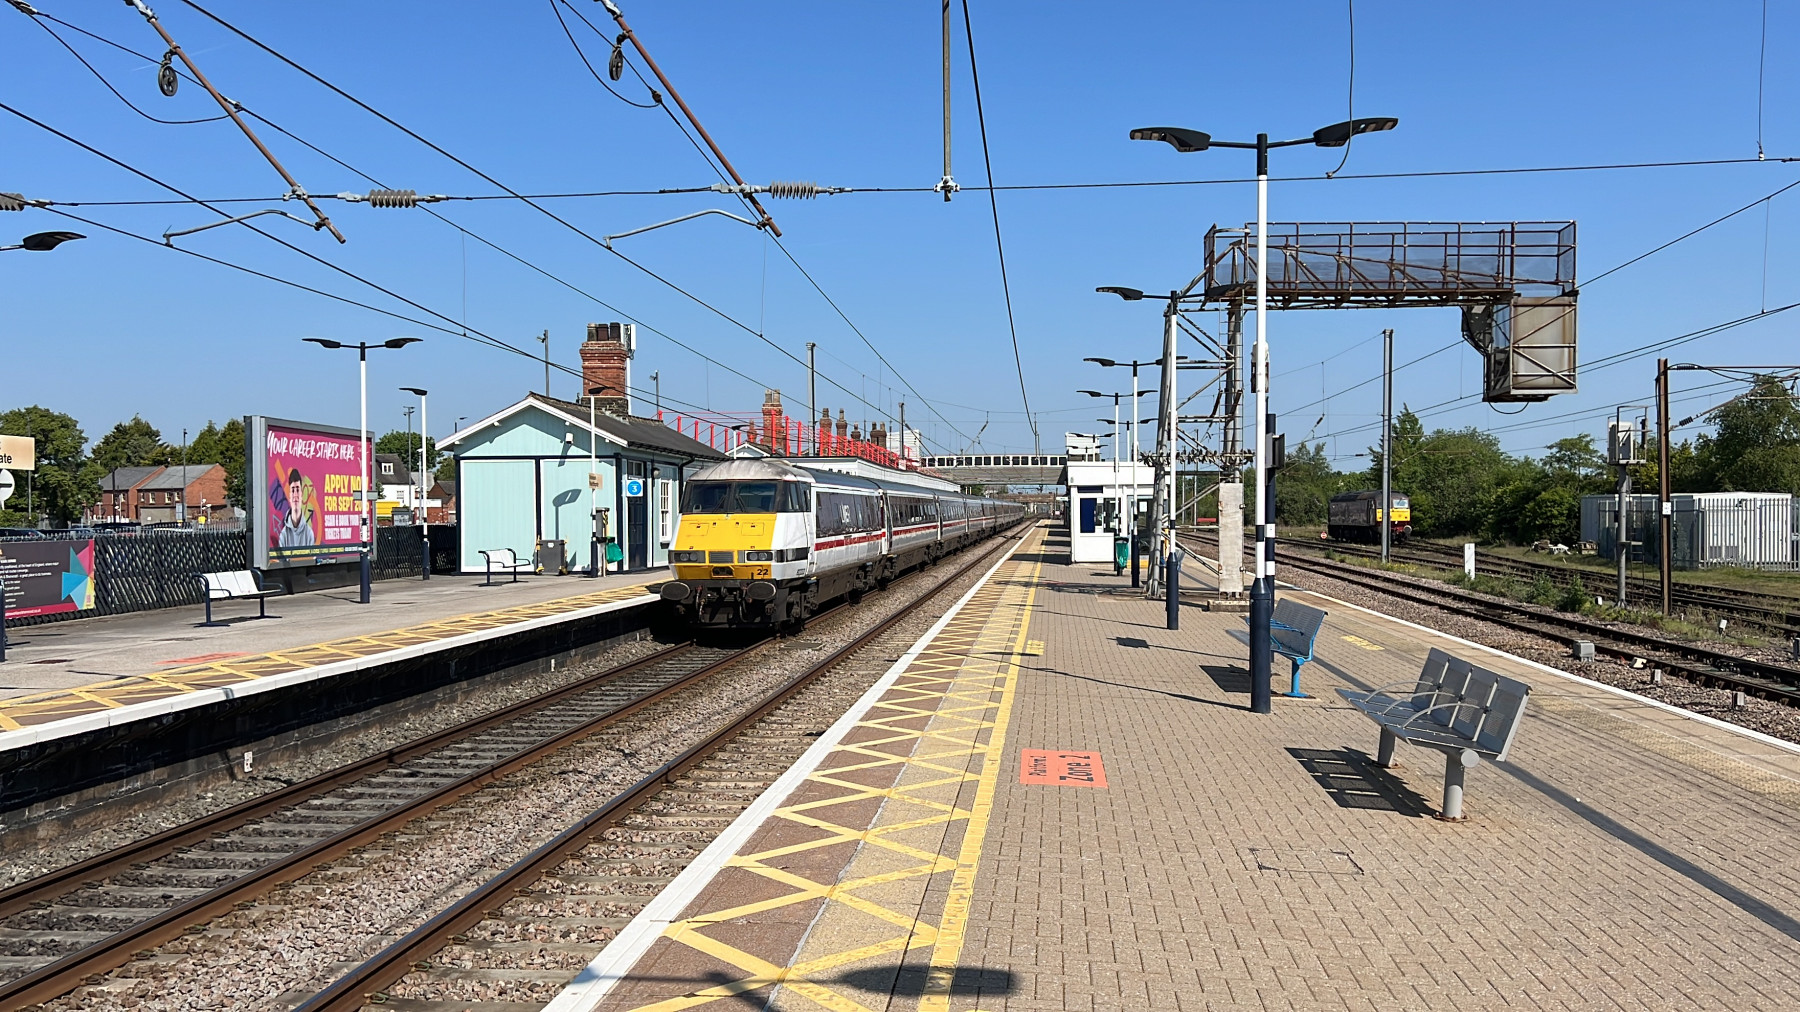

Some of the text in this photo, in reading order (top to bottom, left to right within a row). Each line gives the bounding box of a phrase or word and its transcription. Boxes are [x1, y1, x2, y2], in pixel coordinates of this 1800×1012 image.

[267, 430, 288, 457] YOUR
[289, 438, 315, 459] CAREER
[316, 441, 339, 460] STARTS
[340, 443, 355, 462] HERE
[324, 473, 369, 494] APPLY NO
[631, 485, 638, 493] 3
[324, 495, 338, 512] FOR
[338, 495, 354, 512] SEPT
[1028, 758, 1047, 776] Platform
[1059, 762, 1094, 782] Zone
